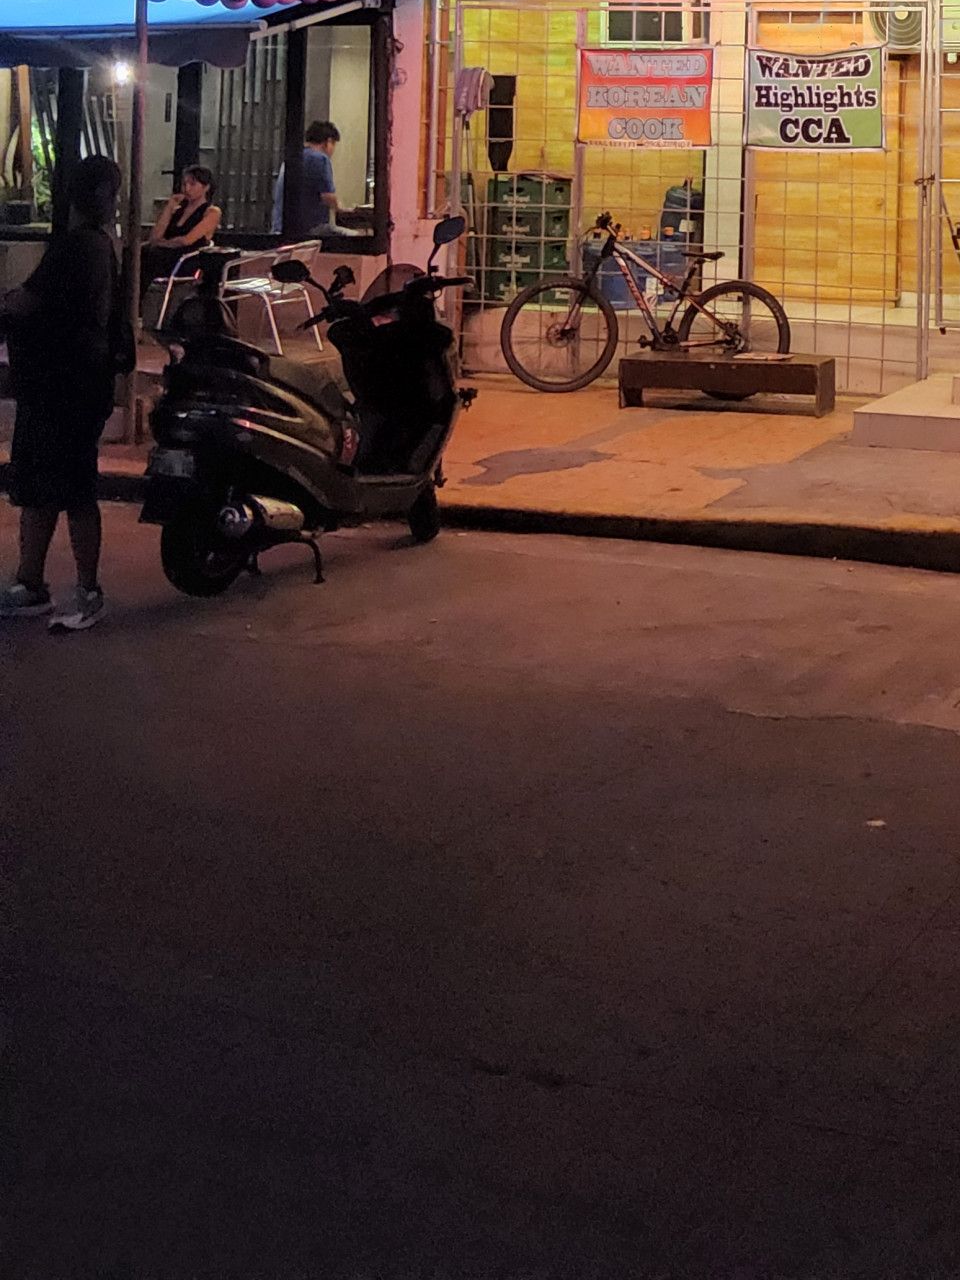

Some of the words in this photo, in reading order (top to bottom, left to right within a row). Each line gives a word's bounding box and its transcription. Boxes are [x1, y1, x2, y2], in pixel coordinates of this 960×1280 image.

[586, 54, 707, 77] WANTED
[756, 54, 871, 78] WANTED
[587, 86, 706, 108] KOREAN
[755, 85, 876, 112] Highlights
[608, 117, 684, 140] COOK
[779, 117, 850, 143] CCA
